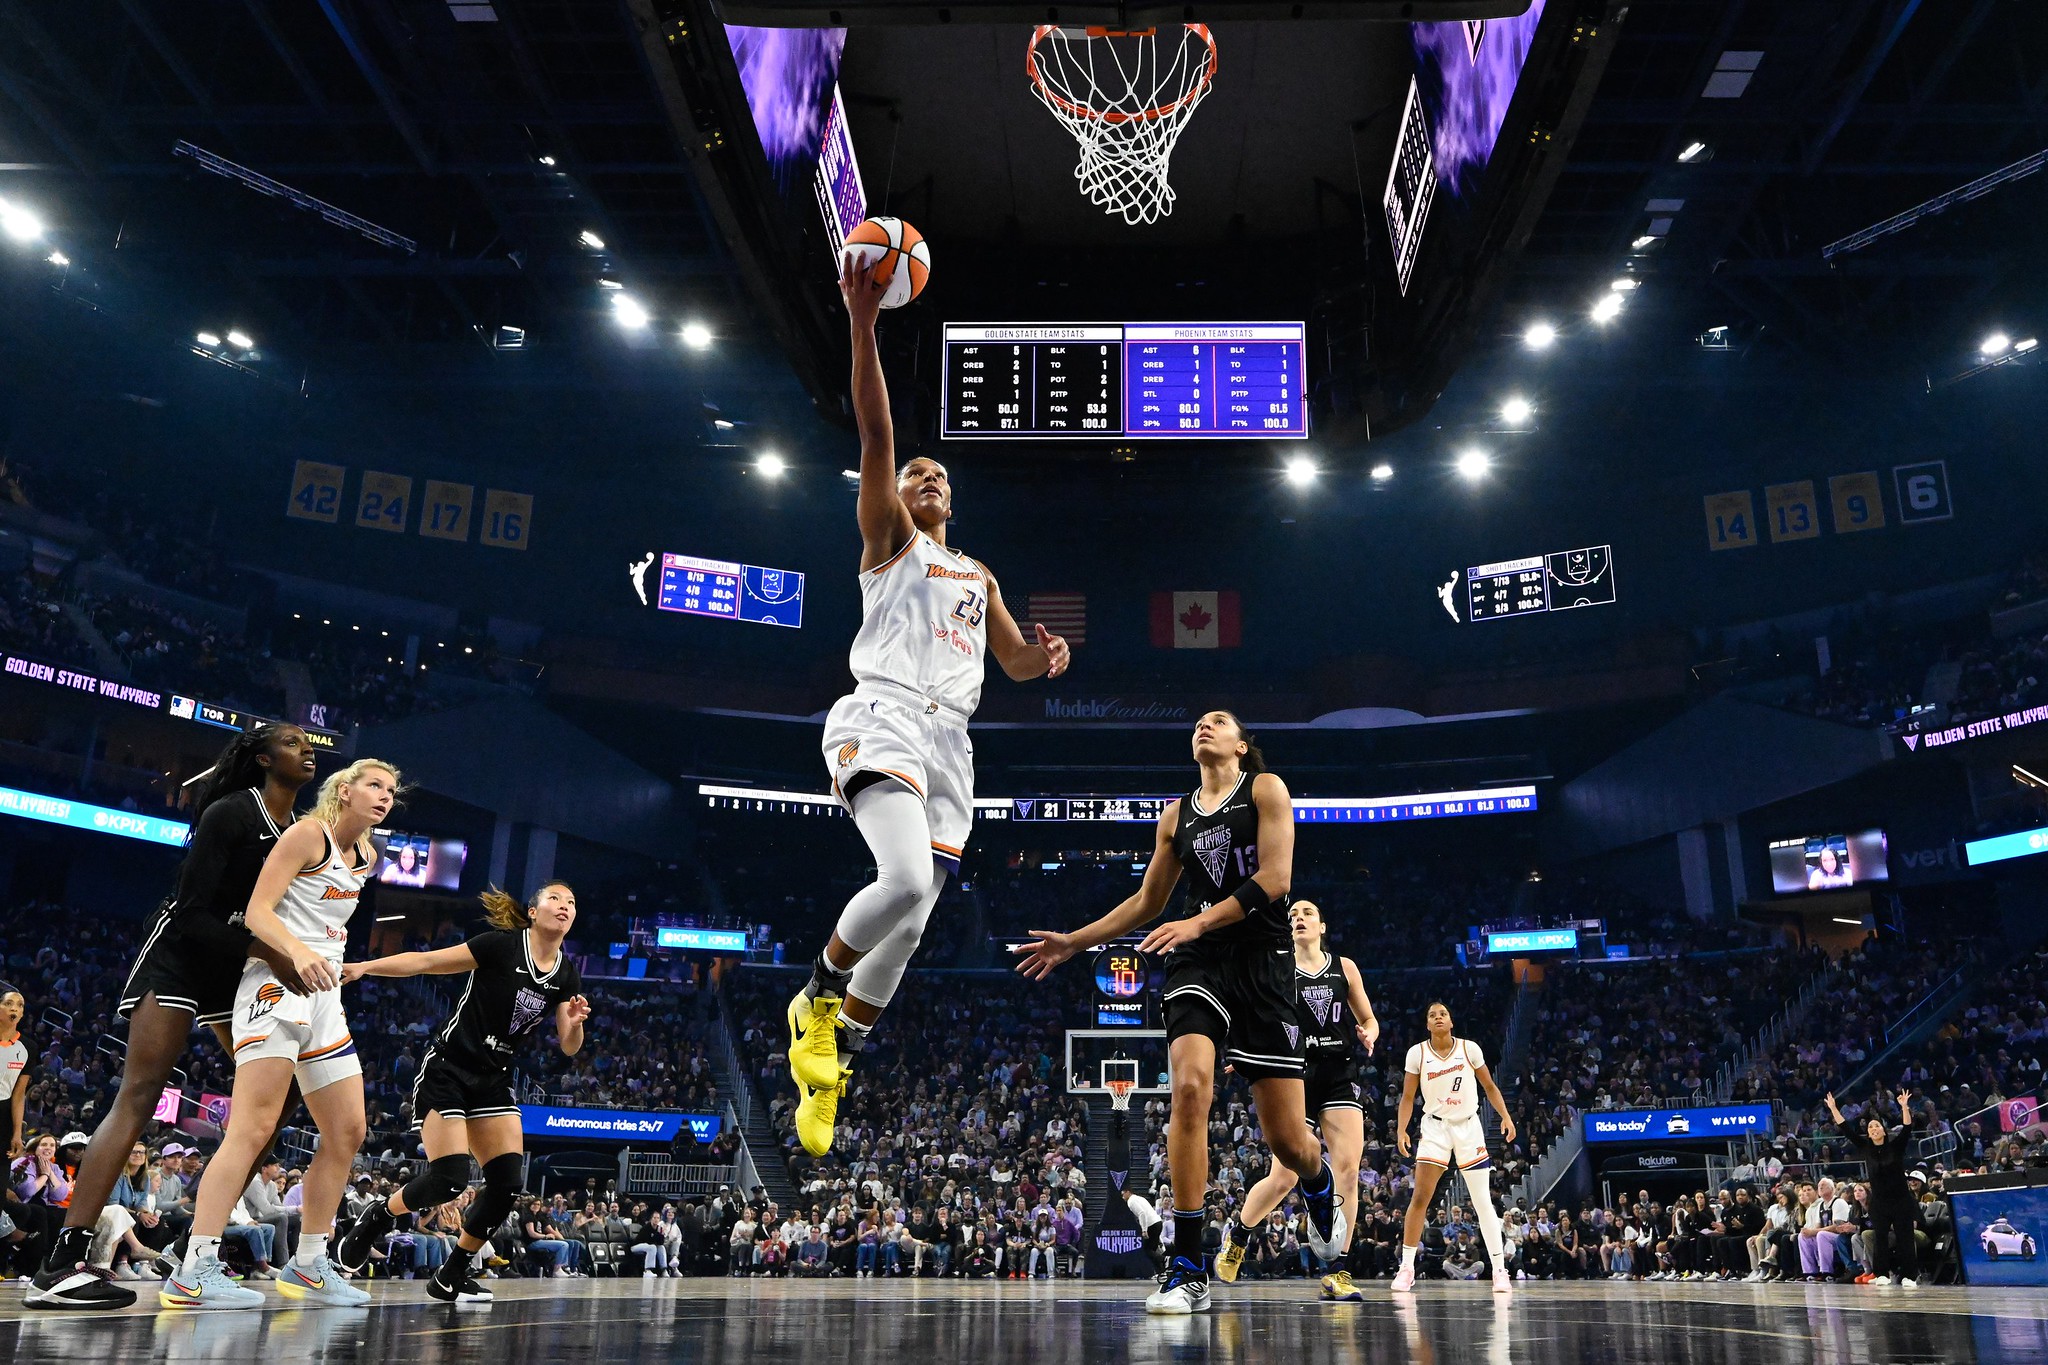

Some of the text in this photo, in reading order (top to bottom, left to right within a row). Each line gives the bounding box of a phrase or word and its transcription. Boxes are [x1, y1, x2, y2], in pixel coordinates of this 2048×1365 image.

[985, 330, 1013, 338] GOLDEN
[1015, 330, 1037, 338] STATE
[1040, 330, 1059, 338] TEAM
[1175, 330, 1206, 338] PHOENIX
[1282, 345, 1286, 355] 1
[1013, 360, 1019, 370] 2
[1102, 360, 1107, 370] 1
[1195, 360, 1199, 370] 1
[1282, 360, 1287, 370] 1
[1013, 375, 1019, 385] 3
[1101, 375, 1107, 385] 2
[1193, 374, 1199, 384] 4
[1280, 374, 1287, 384] 0
[1014, 389, 1019, 399] 1
[1100, 389, 1107, 399] 4
[1193, 389, 1200, 399] 0
[998, 404, 1019, 414] 50.0
[1001, 418, 1019, 428] 57.1
[1082, 418, 1107, 428] 100.0
[1263, 418, 1288, 428] 100.0
[1907, 475, 1939, 510] 6
[295, 483, 338, 515] 42
[361, 492, 403, 525] 24
[1847, 495, 1869, 523] 9
[431, 503, 462, 533] 17
[1776, 502, 1811, 535] 13
[489, 511, 522, 542] 16
[1715, 512, 1748, 543] 14
[1503, 560, 1533, 570] TRACKER
[1494, 590, 1507, 600] 4/7
[950, 587, 985, 630] 25
[5, 657, 161, 708] GOLDEN STATE VALKYRIES
[1045, 698, 1105, 718] Modelo
[203, 707, 237, 725] TOR 7
[1925, 727, 1965, 747] GOLDEN
[1968, 717, 2002, 738] STATE
[733, 799, 739, 809] 2
[756, 800, 763, 811] 3
[781, 803, 785, 813] 1
[828, 806, 832, 816] 1
[1089, 800, 1094, 809] 4
[1104, 801, 1130, 813] 2:22
[1323, 809, 1327, 819] 1
[1346, 809, 1351, 819] 1
[1506, 797, 1530, 809] 100.0
[985, 809, 1007, 819] 100.0
[1044, 803, 1058, 818] 21
[108, 816, 148, 834] KPIX
[1193, 828, 1232, 850] VALKYRIES
[1233, 845, 1259, 877] 13
[673, 933, 699, 944] KPIX
[708, 935, 740, 945] KPIX+
[1505, 936, 1529, 946] KPIX
[1538, 934, 1571, 945] KPIX+
[1110, 958, 1138, 971] 2:21
[1115, 971, 1135, 994] 10
[516, 989, 547, 1010] VALKYRIES
[1301, 989, 1334, 999] VALKYRIES
[1333, 1002, 1341, 1022] 0
[1451, 1077, 1463, 1093] 8
[546, 1115, 663, 1133] Autonomous rides 24/7
[1712, 1115, 1756, 1126] WAYMO
[1596, 1120, 1646, 1133] Ride today
[1638, 1156, 1677, 1167] Rakuten
[1096, 1237, 1142, 1254] VALKYRIES
